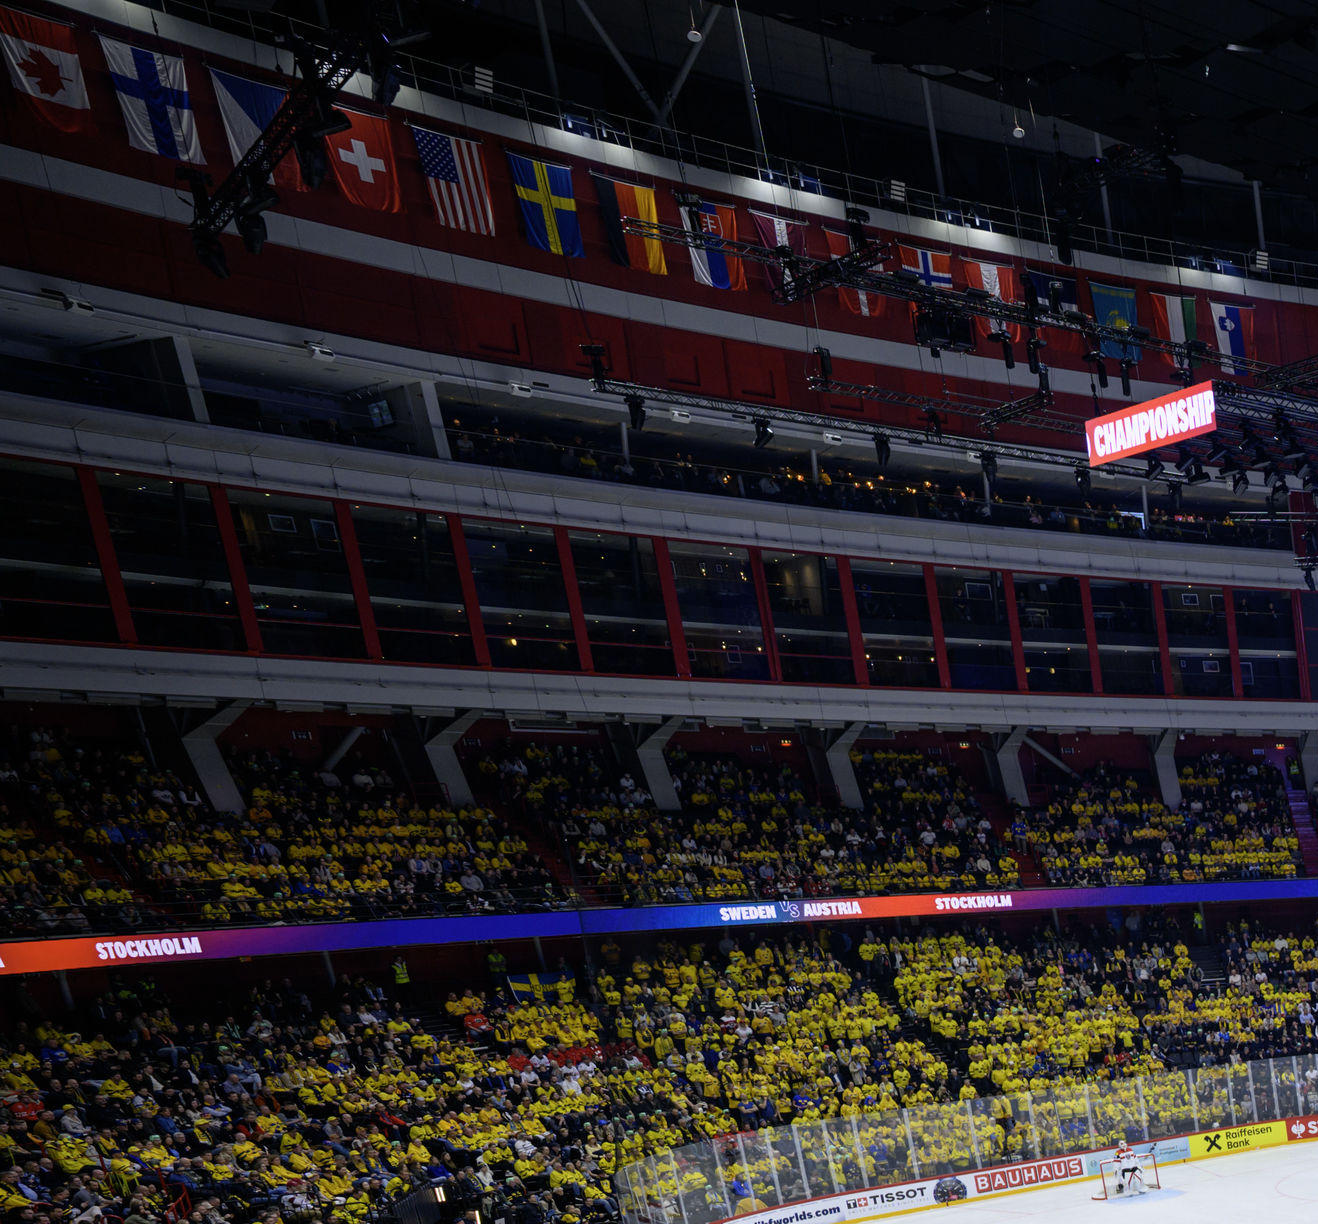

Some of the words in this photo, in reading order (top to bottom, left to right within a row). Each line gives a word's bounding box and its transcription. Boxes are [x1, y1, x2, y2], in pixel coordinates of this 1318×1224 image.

[1093, 389, 1216, 458] CHAMPIONSHIP
[719, 904, 778, 920] SWEDEN
[779, 900, 800, 919] VS
[802, 901, 862, 917] AUSTRIA
[935, 894, 1013, 911] STOCKHOLM
[95, 936, 203, 961] STOCKHOLM
[1225, 1125, 1272, 1141] Raiffeisen
[1226, 1138, 1250, 1150] Bank
[978, 1158, 1083, 1190] BAUHAUS
[868, 1186, 927, 1205] TISSOT
